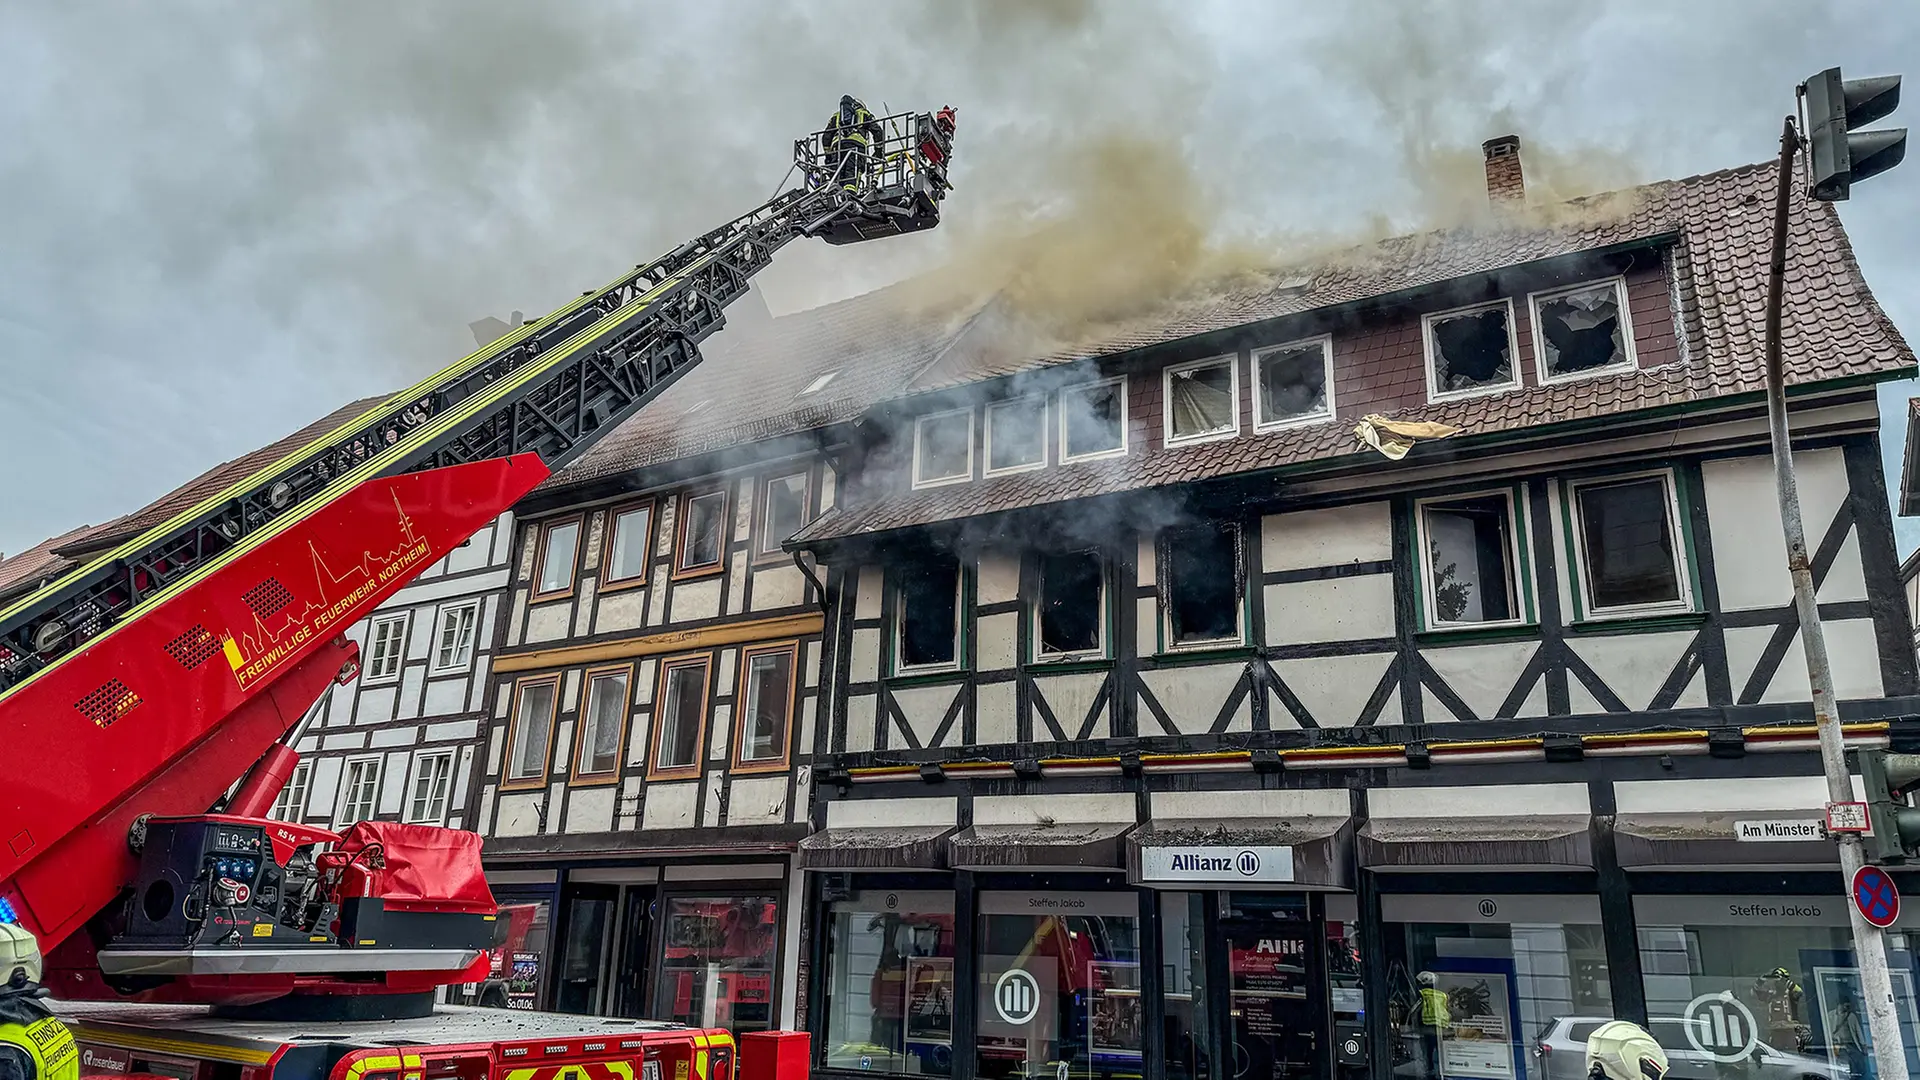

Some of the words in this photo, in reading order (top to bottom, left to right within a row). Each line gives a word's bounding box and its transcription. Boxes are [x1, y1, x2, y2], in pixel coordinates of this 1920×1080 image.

[238, 625, 312, 684] FREIWILLIGE
[313, 579, 377, 629] FEUERWEHR
[378, 543, 427, 583] NORTHEIM
[277, 828, 289, 840] RS
[288, 833, 297, 843] 14
[1742, 824, 1762, 837] Am
[1764, 822, 1816, 836] Münster
[1170, 854, 1233, 871] Allianz
[1028, 897, 1059, 908] Steffen
[1059, 898, 1086, 908] Jakob
[1729, 904, 1778, 917] Steffen
[1780, 905, 1822, 917] Jakob
[91, 1056, 126, 1071] rosenbauer
